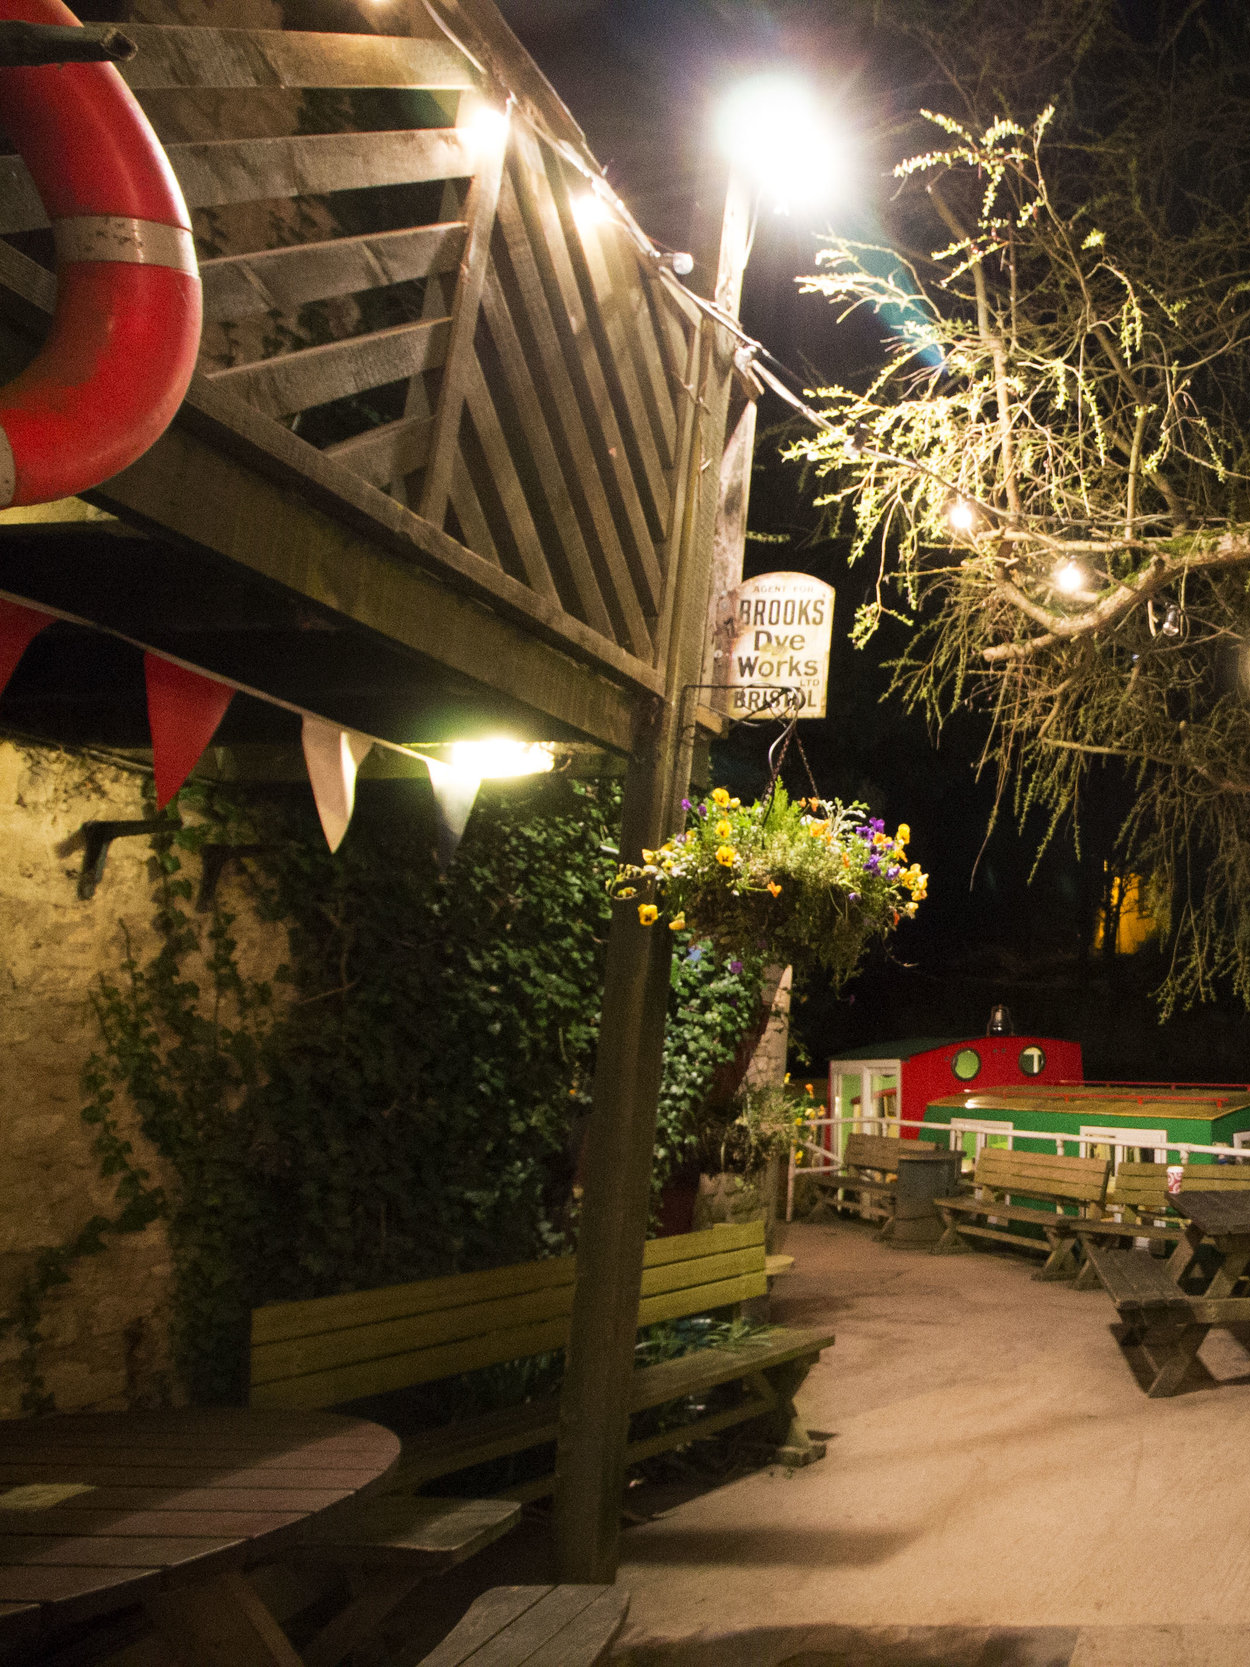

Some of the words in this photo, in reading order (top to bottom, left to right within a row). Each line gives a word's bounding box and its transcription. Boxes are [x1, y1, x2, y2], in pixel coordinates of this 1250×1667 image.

[752, 585, 787, 593] AGENT
[740, 599, 825, 626] BROOKS
[754, 630, 806, 655] Dye
[737, 656, 818, 678] Works
[800, 679, 820, 687] LTD
